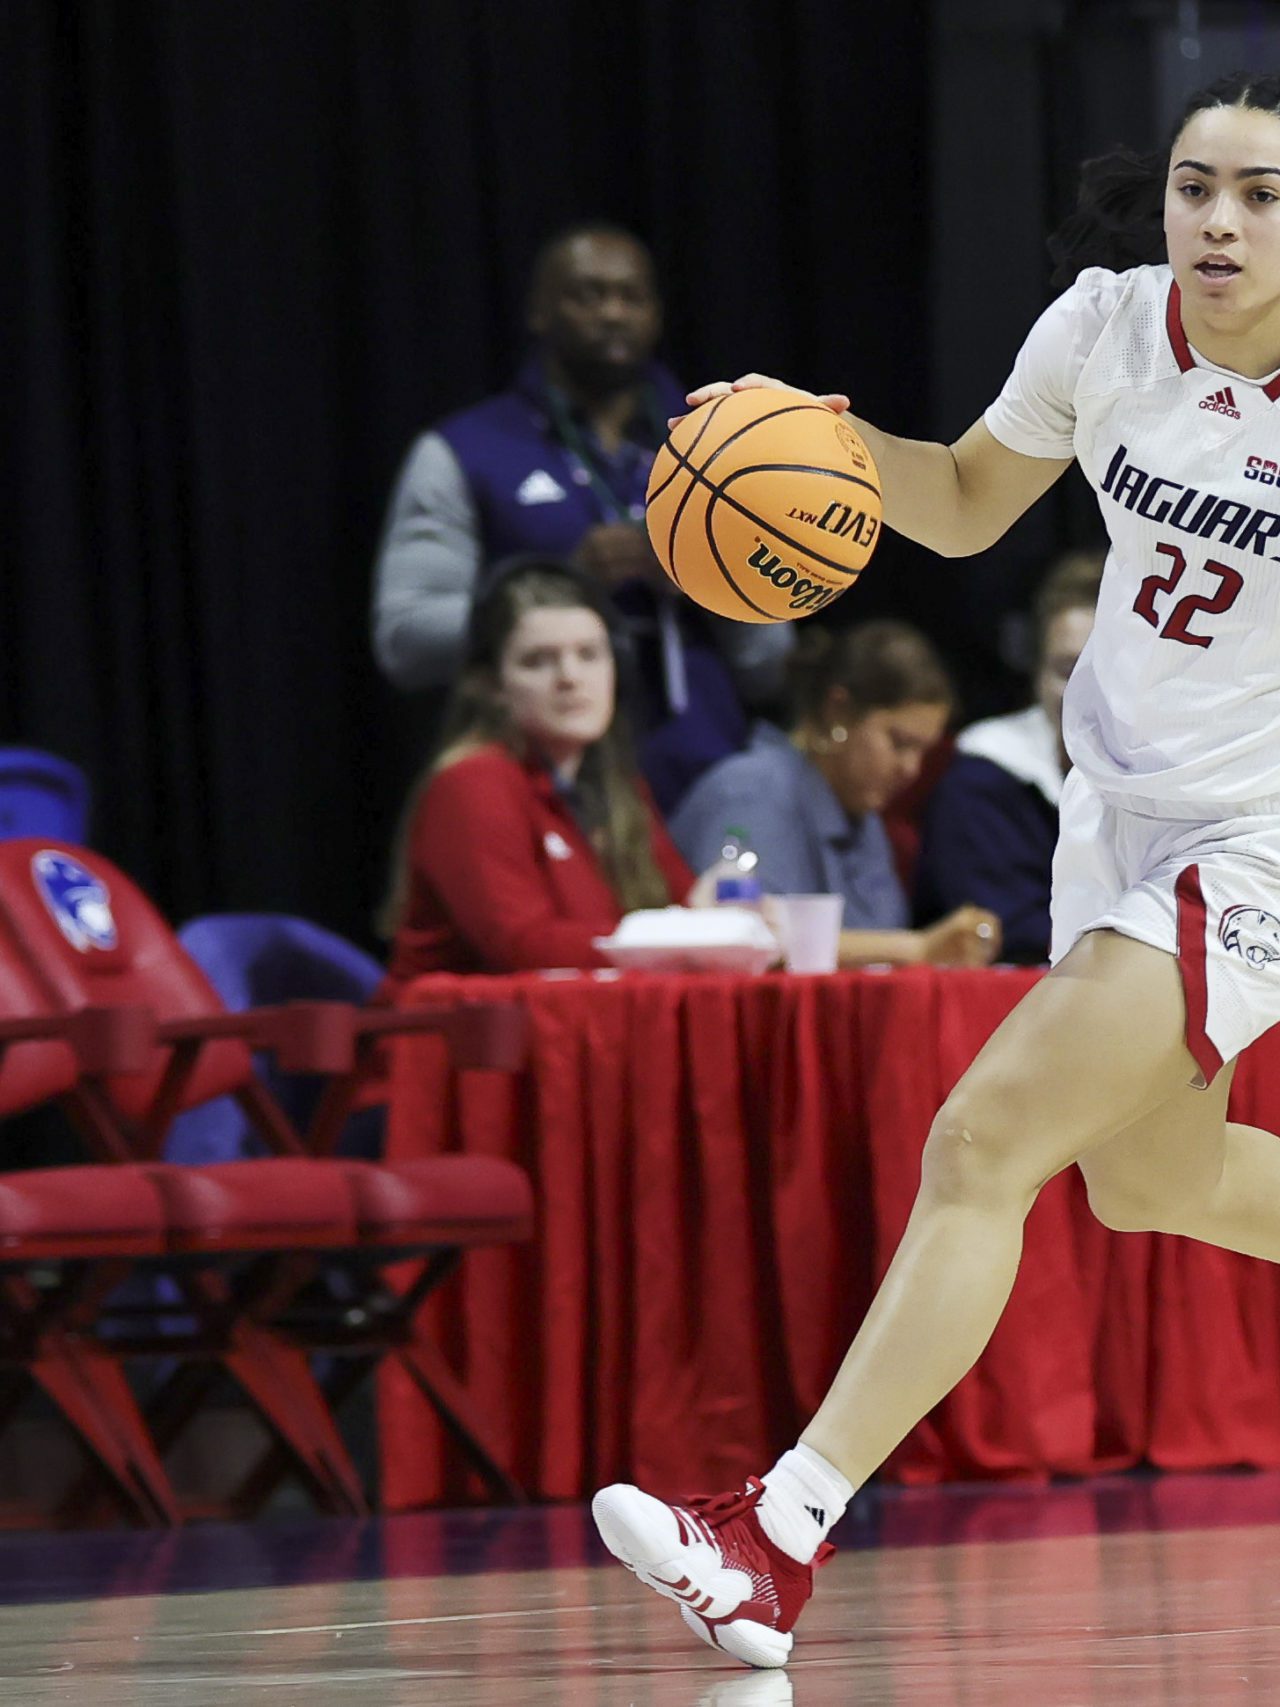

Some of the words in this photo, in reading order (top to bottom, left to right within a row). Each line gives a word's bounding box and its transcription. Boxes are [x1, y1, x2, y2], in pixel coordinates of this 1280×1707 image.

[1198, 400, 1241, 420] adidas
[785, 507, 819, 526] NXT
[1132, 541, 1244, 649] 22
